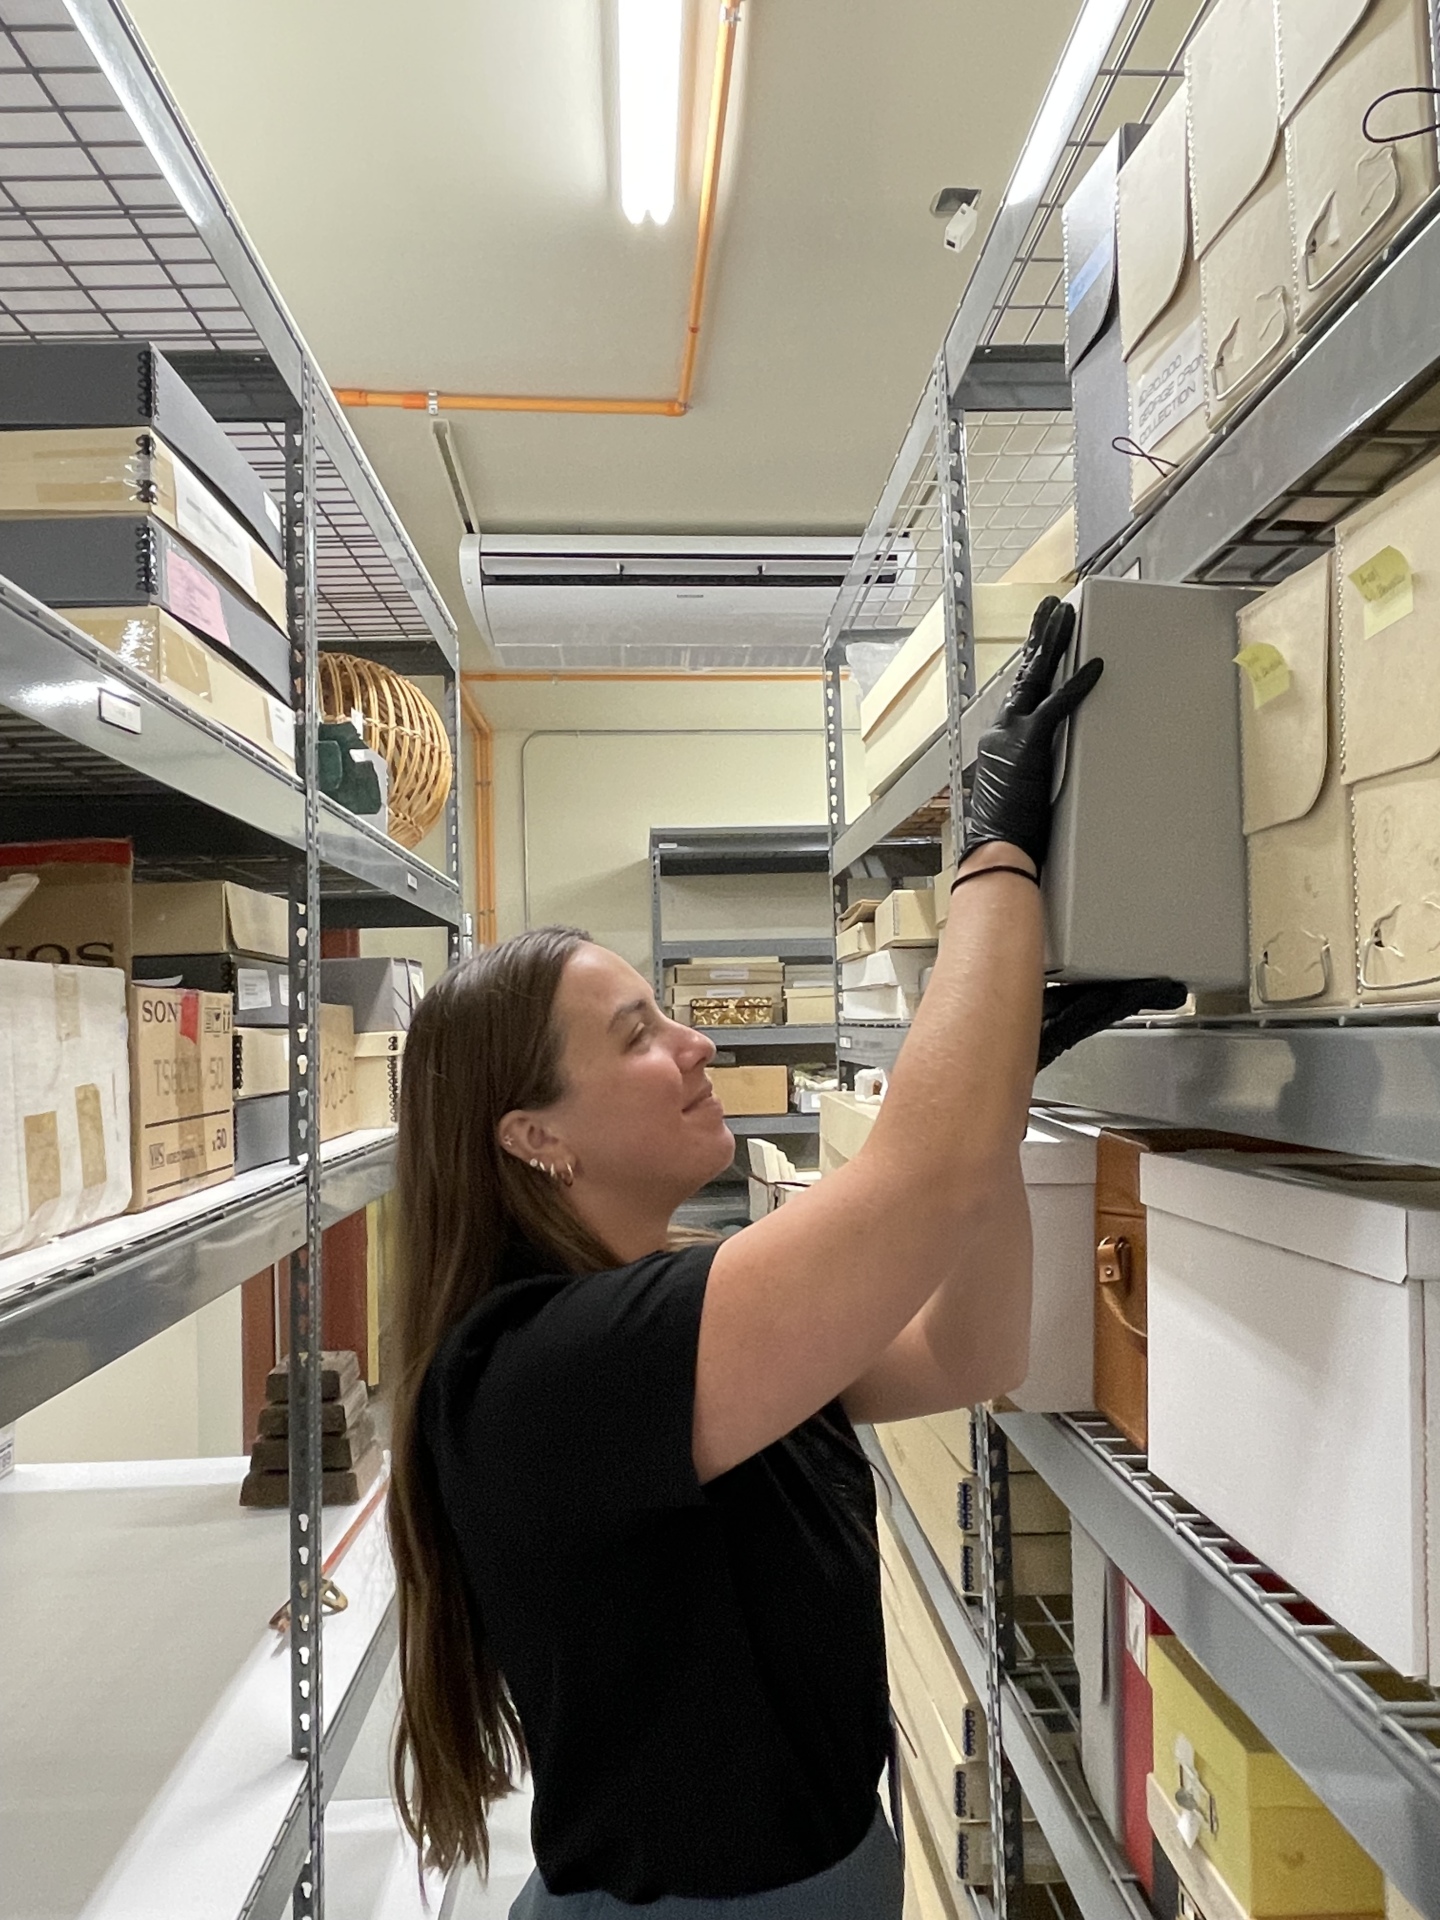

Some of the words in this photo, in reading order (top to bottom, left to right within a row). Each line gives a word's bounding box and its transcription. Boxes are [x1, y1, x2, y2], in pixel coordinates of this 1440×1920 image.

[1139, 380, 1175, 428] GEORGE
[1140, 380, 1196, 445] COLLECTION
[142, 1000, 182, 1023] SON
